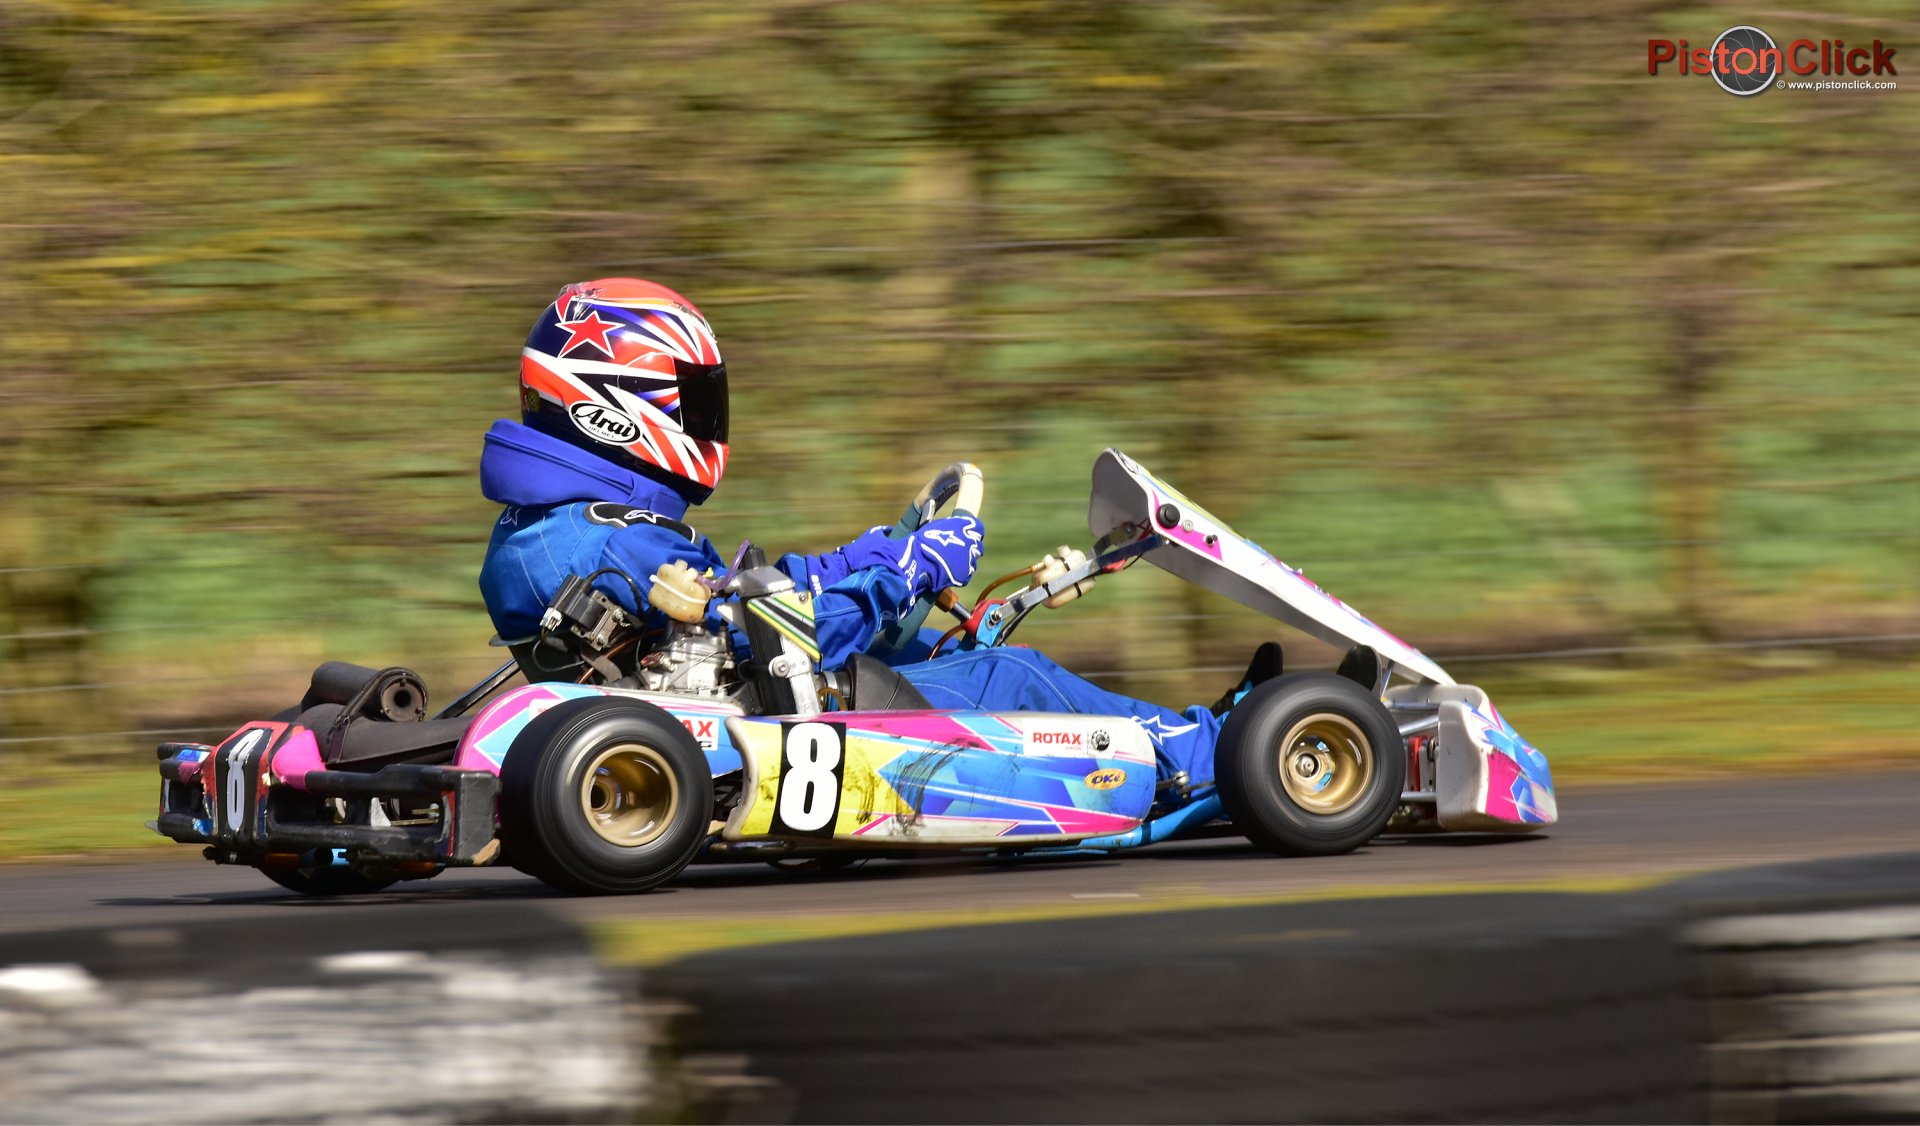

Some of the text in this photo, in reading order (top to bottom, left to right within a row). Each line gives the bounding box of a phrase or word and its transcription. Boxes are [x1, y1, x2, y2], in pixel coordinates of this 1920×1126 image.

[573, 408, 633, 437] Arai
[1033, 732, 1082, 745] ROTAX
[227, 729, 264, 830] 8
[780, 722, 841, 831] 8
